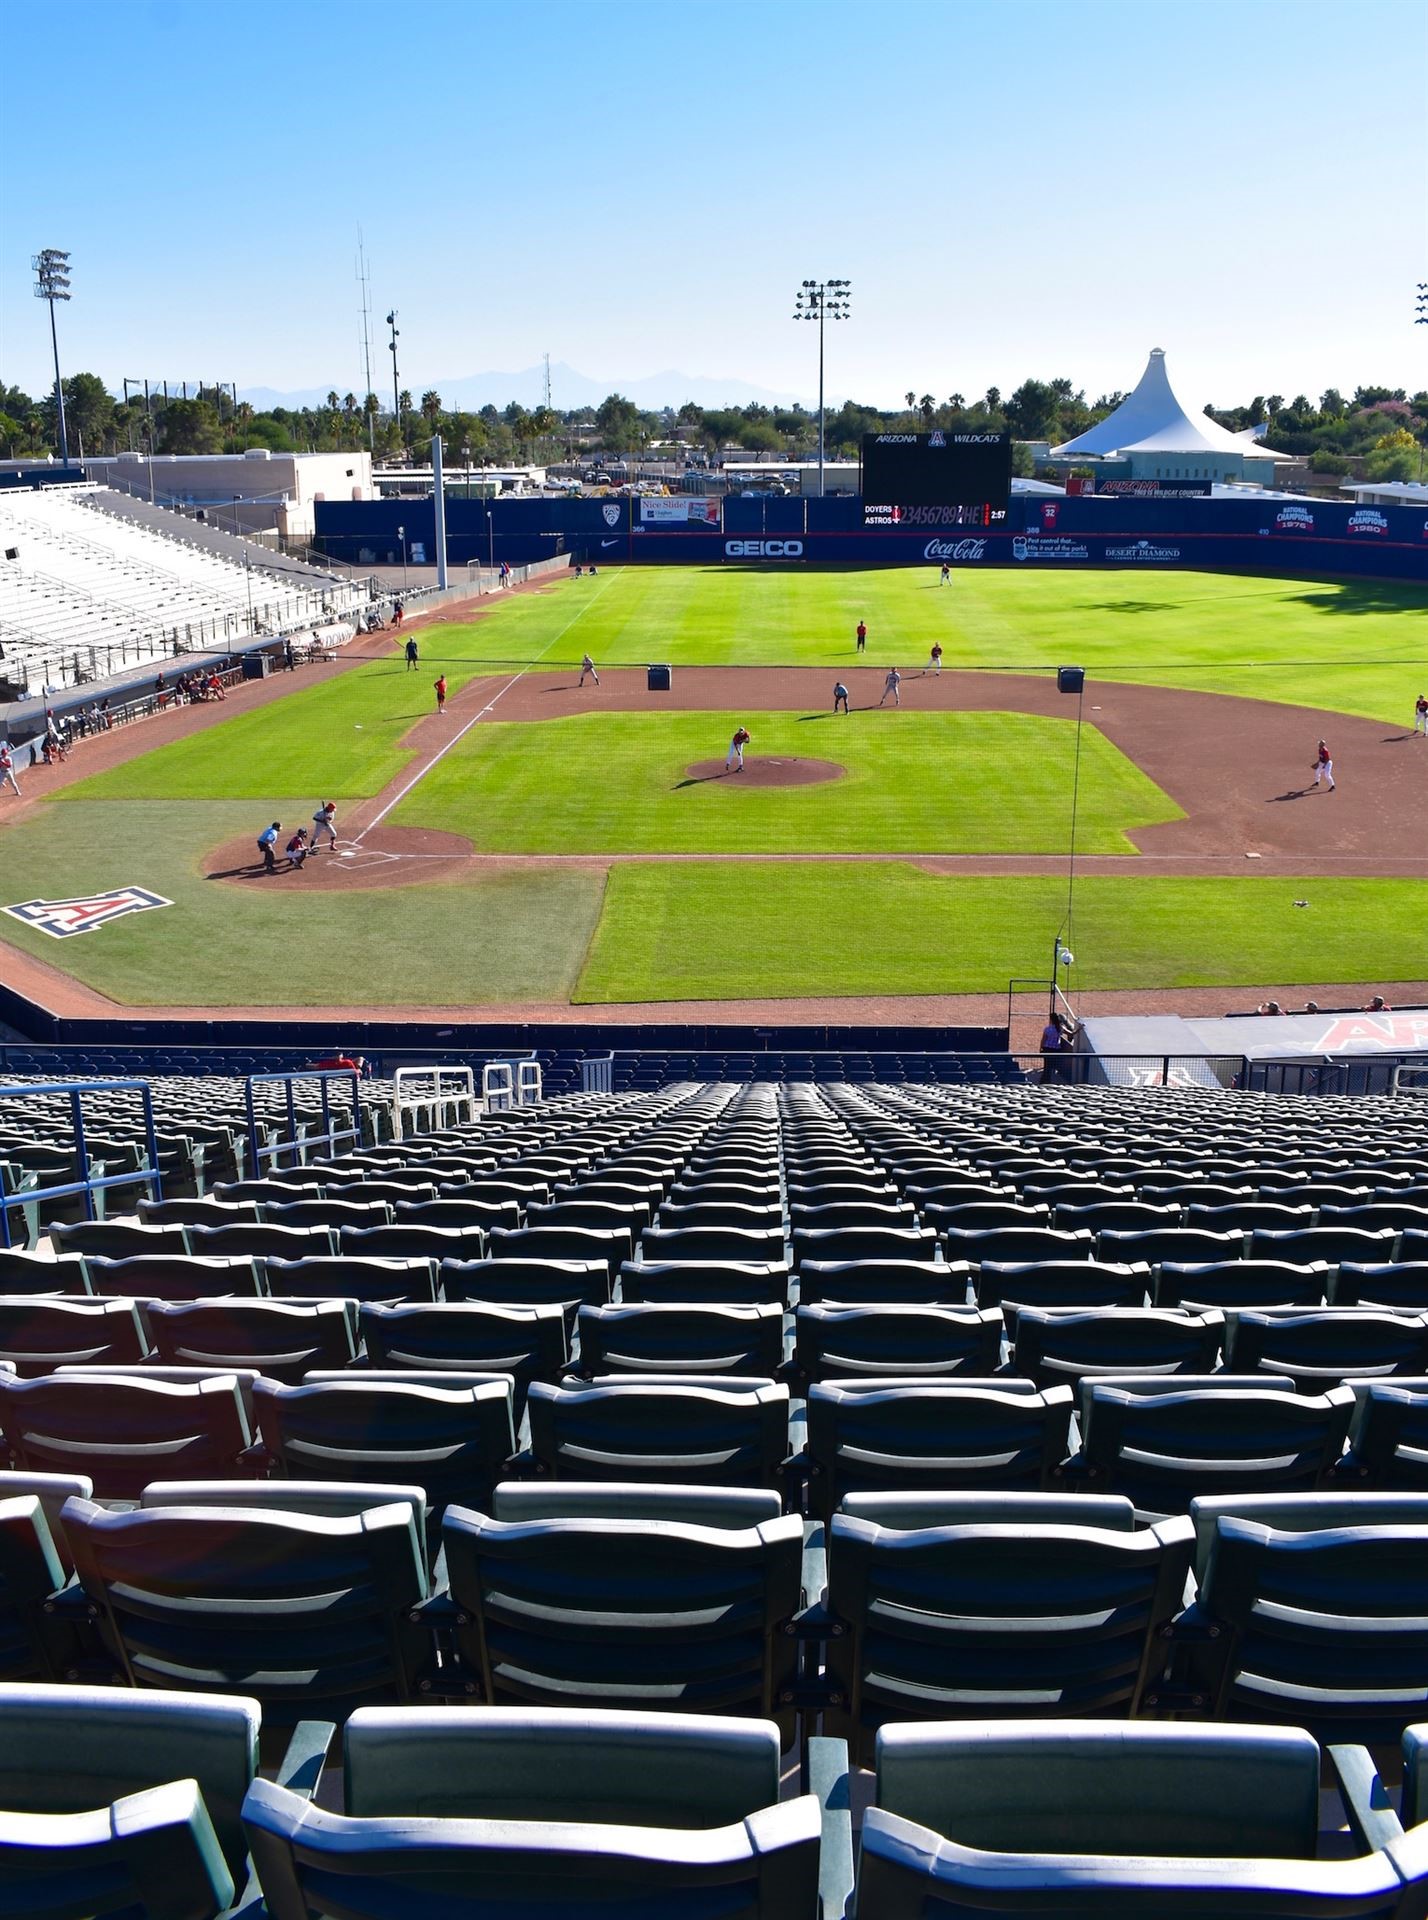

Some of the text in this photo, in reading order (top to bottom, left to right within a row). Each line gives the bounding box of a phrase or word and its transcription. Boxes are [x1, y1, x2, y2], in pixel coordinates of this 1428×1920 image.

[875, 434, 917, 443] ARIZONA
[954, 434, 1000, 443] WILDCATS
[1100, 480, 1160, 492] ARIZONA
[642, 500, 687, 509] Nice Slide!
[865, 505, 892, 513] DOYERS
[991, 510, 1006, 519] 2:57
[1045, 508, 1055, 517] 32
[1283, 506, 1308, 515] NATIONAL
[1355, 510, 1382, 518] NATIONAL
[865, 516, 892, 524] ASTROS
[1276, 513, 1314, 524] CHAMPIONS
[1348, 517, 1388, 527] CHAMPIONS
[1282, 521, 1306, 529] 1976
[1354, 525, 1380, 533] 1980
[725, 540, 803, 556] GEICO
[924, 538, 988, 559] Coca-Cola
[1071, 544, 1087, 553] park!
[1105, 549, 1180, 557] DESERT DIAMOND
[0, 885, 176, 939] A
